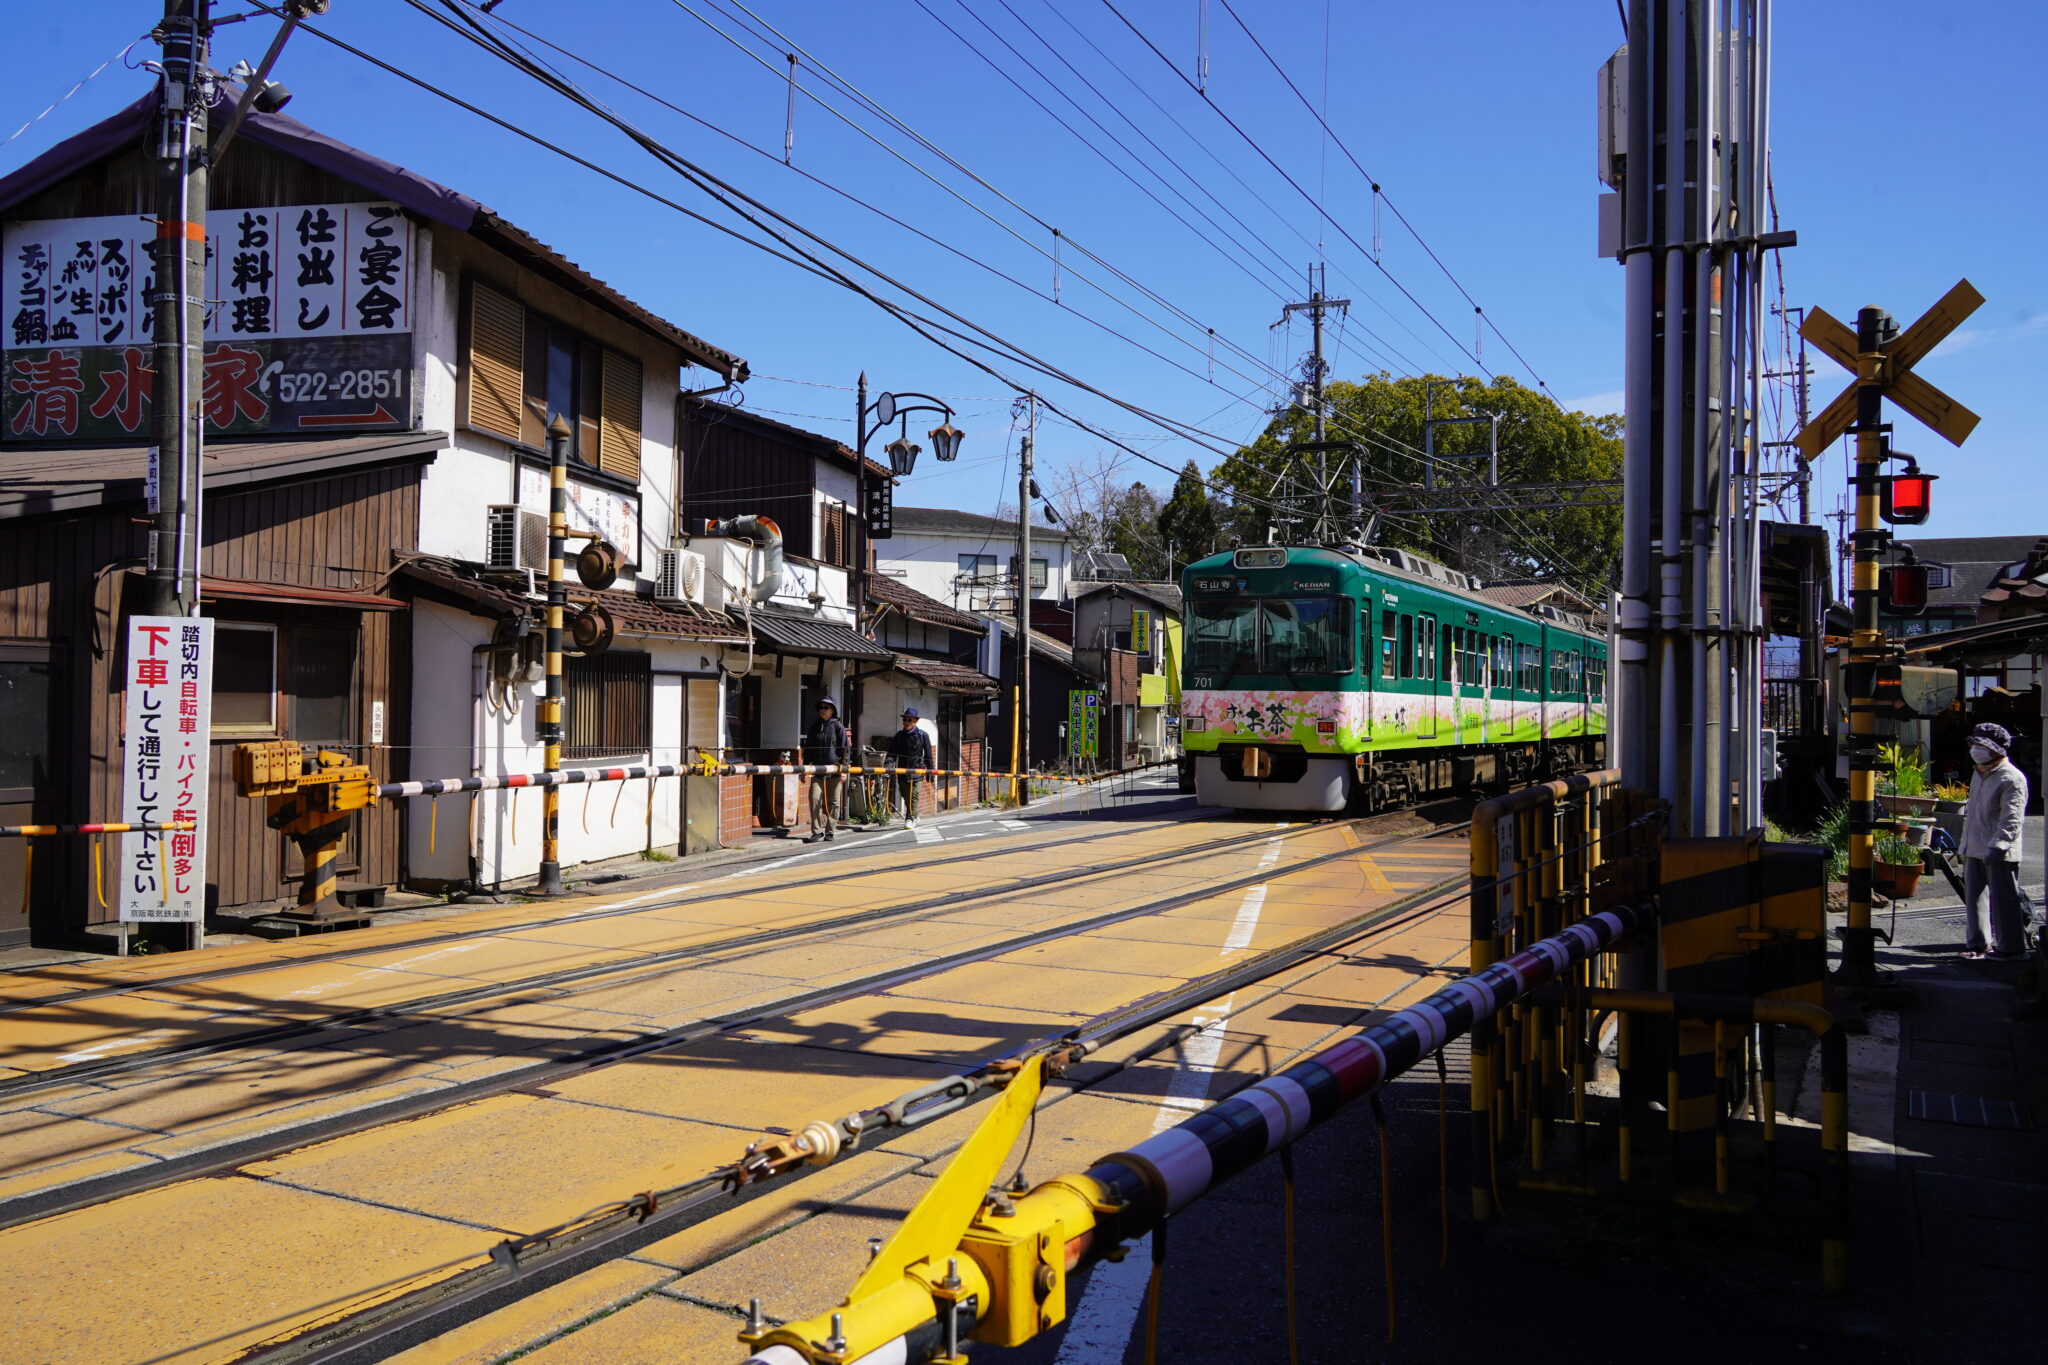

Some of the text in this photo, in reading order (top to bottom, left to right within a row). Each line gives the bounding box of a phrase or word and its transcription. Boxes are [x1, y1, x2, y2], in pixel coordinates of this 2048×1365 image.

[12, 243, 49, 346] チャンコ鍋
[98, 238, 131, 344] スッポン
[231, 211, 274, 334] お料理
[296, 208, 338, 331] 仕出し
[356, 206, 402, 330] ご宴会
[10, 344, 270, 437] 清水家
[279, 368, 402, 404] 522-2851
[1198, 580, 1230, 589] 石山寺
[1086, 710, 1096, 743] 駐車場
[1087, 695, 1096, 706] P
[1193, 676, 1213, 688] 701
[134, 625, 171, 894] 下車して通行して下さい
[130, 900, 192, 909] 大津市
